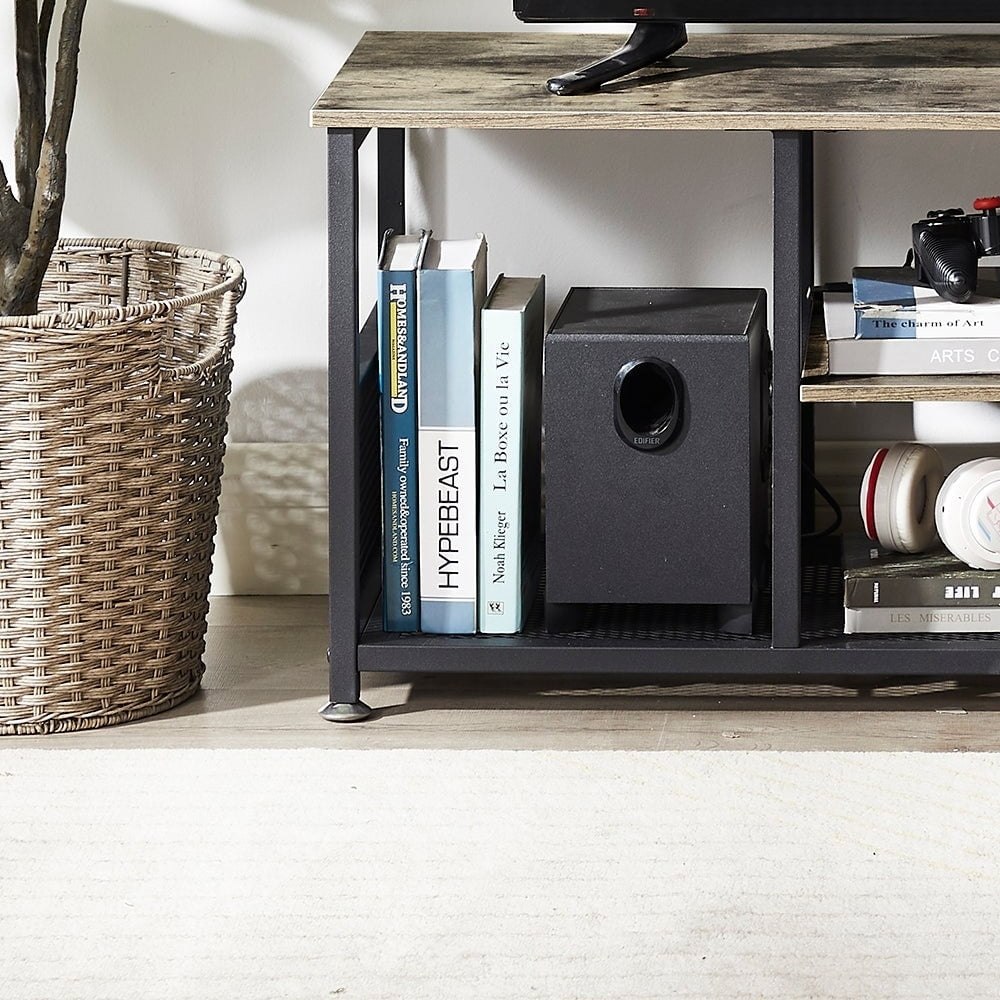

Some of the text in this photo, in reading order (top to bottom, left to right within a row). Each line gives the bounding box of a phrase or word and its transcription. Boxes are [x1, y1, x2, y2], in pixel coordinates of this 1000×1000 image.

[871, 318, 985, 329] The charm of Art
[930, 348, 975, 363] ARTS
[493, 342, 509, 491] La Boxe ou la Vie
[396, 437, 410, 473] Family
[437, 440, 459, 589] HYPEBEAST
[492, 511, 508, 584] Noah Klieger
[400, 563, 410, 589] since
[400, 591, 412, 616] 1983
[944, 585, 980, 599] LIFE
[890, 612, 992, 624] LES MISERABLES
